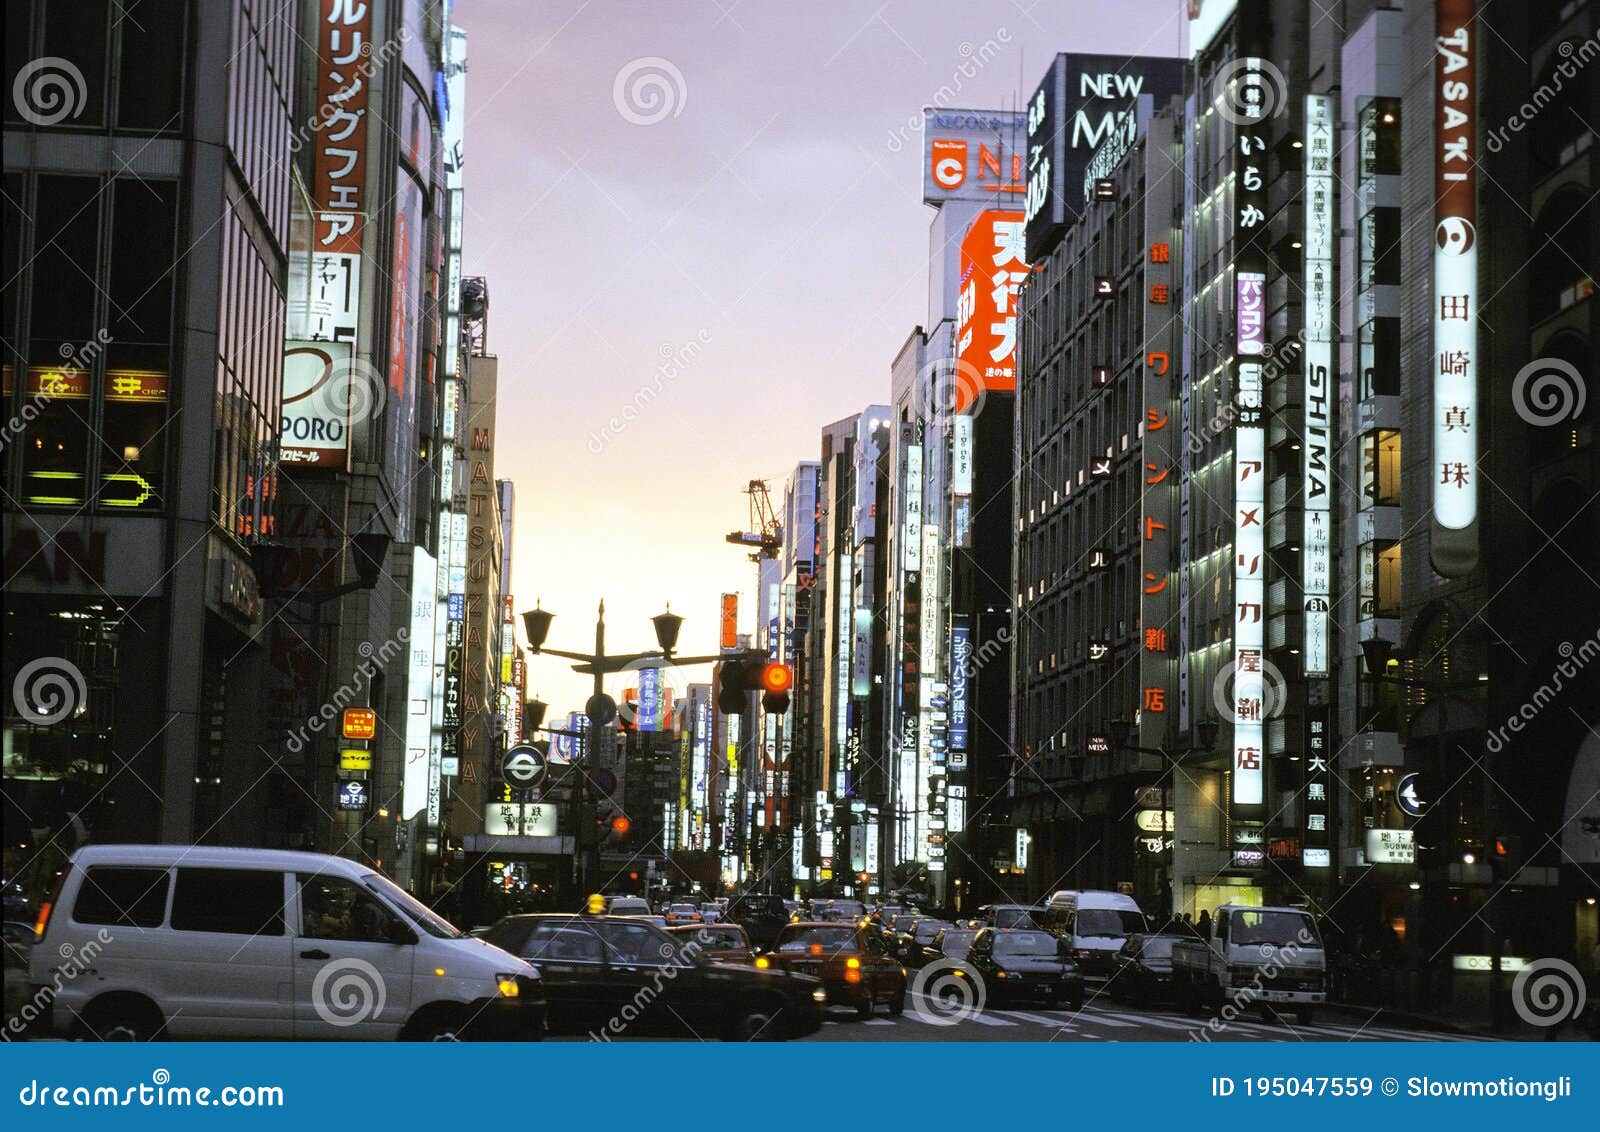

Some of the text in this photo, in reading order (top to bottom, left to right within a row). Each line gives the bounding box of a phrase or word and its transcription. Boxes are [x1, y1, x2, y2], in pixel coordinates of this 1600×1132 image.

[1081, 73, 1144, 99] NEW
[1436, 27, 1469, 182] TASAKI
[1240, 135, 1266, 228] いらか
[1241, 280, 1262, 340] パソコン
[1240, 411, 1261, 423] 3F
[1309, 362, 1327, 499] SHIMA
[1439, 294, 1471, 489] 田崎真珠
[1143, 243, 1169, 713] 銀座ワシントン靴店
[461, 427, 490, 785] MATSUZAKAYA
[1236, 460, 1262, 771] アメリカ屋靴店
[1310, 600, 1323, 611] B1
[408, 600, 432, 765] 銀座コア
[952, 635, 967, 724] シティバンク銀行
[501, 804, 542, 817] 地鉄
[1307, 721, 1327, 831] 銀座大黒屋
